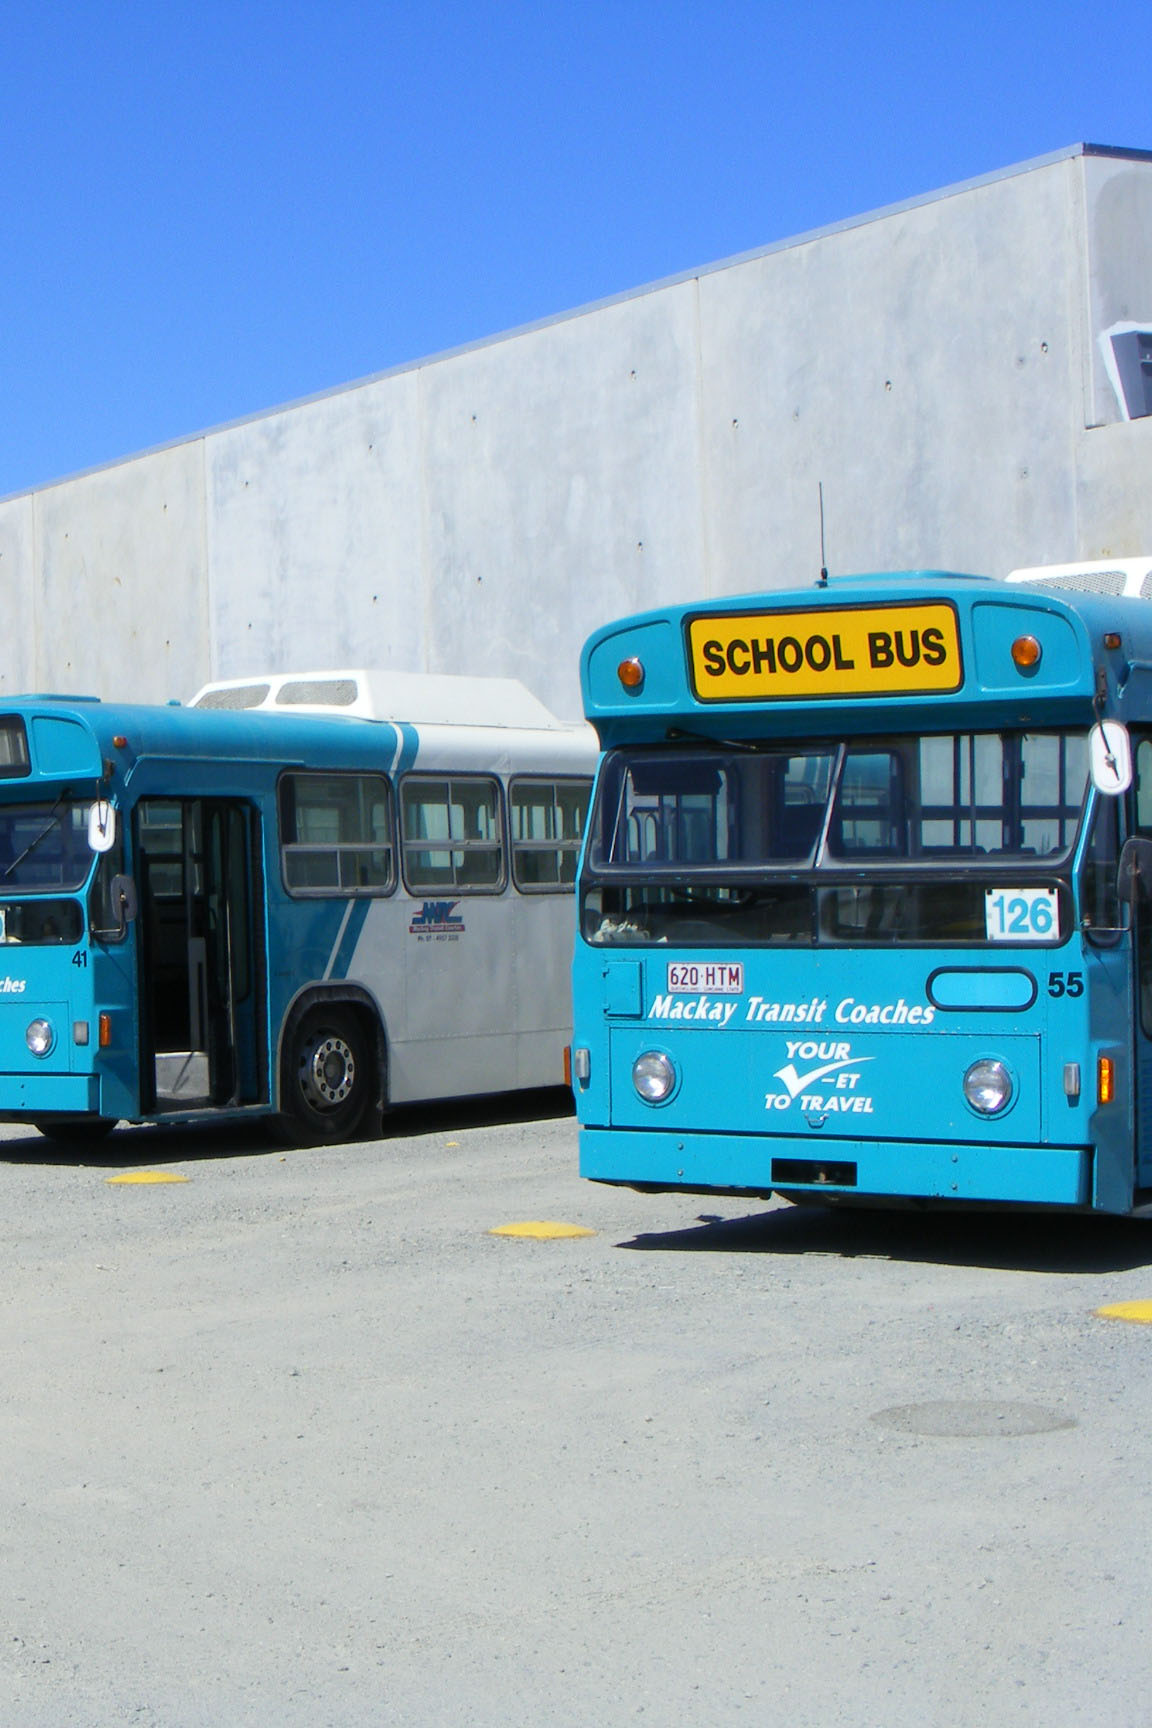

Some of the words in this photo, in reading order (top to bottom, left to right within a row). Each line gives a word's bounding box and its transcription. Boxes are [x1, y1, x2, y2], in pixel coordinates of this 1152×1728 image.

[702, 636, 854, 677] SCHOOL
[869, 628, 948, 668] BUS
[992, 899, 1054, 935] 126
[72, 951, 88, 968] 41
[670, 966, 698, 985] 620
[705, 966, 739, 986] HTM
[1048, 972, 1084, 998] 55
[648, 995, 738, 1027] Mackay
[745, 996, 826, 1023] Transit
[835, 997, 936, 1025] Coaches
[785, 1041, 852, 1061] YOUR
[764, 1094, 793, 1111] TO
[800, 1095, 874, 1114] TRAVEL
